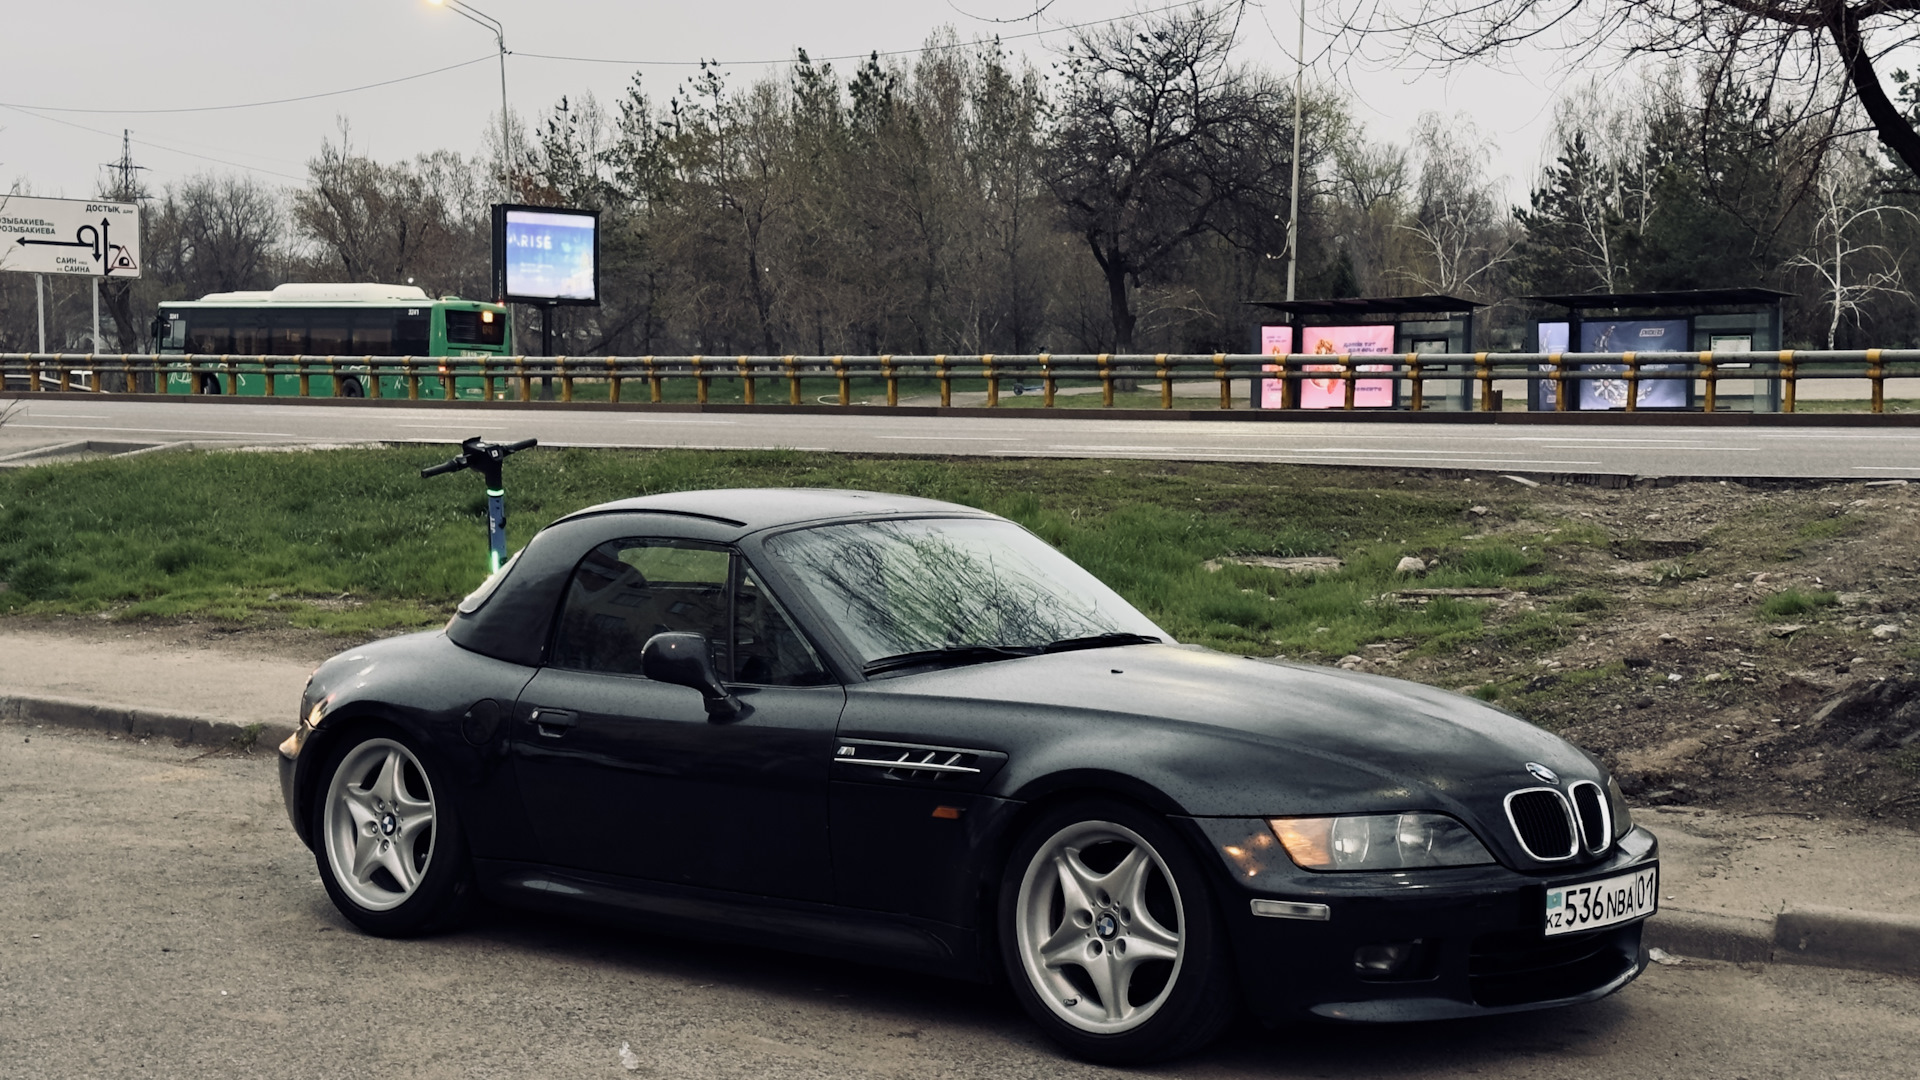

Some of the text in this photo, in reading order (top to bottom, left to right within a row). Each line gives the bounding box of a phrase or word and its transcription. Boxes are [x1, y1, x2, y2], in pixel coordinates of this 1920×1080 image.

[0, 217, 45, 226] ЗЫБАКИЕВ
[56, 257, 77, 265] САИН
[64, 265, 91, 273] САИНА
[1565, 872, 1654, 927] 536 NBA 01
[1545, 912, 1562, 929] KZ
